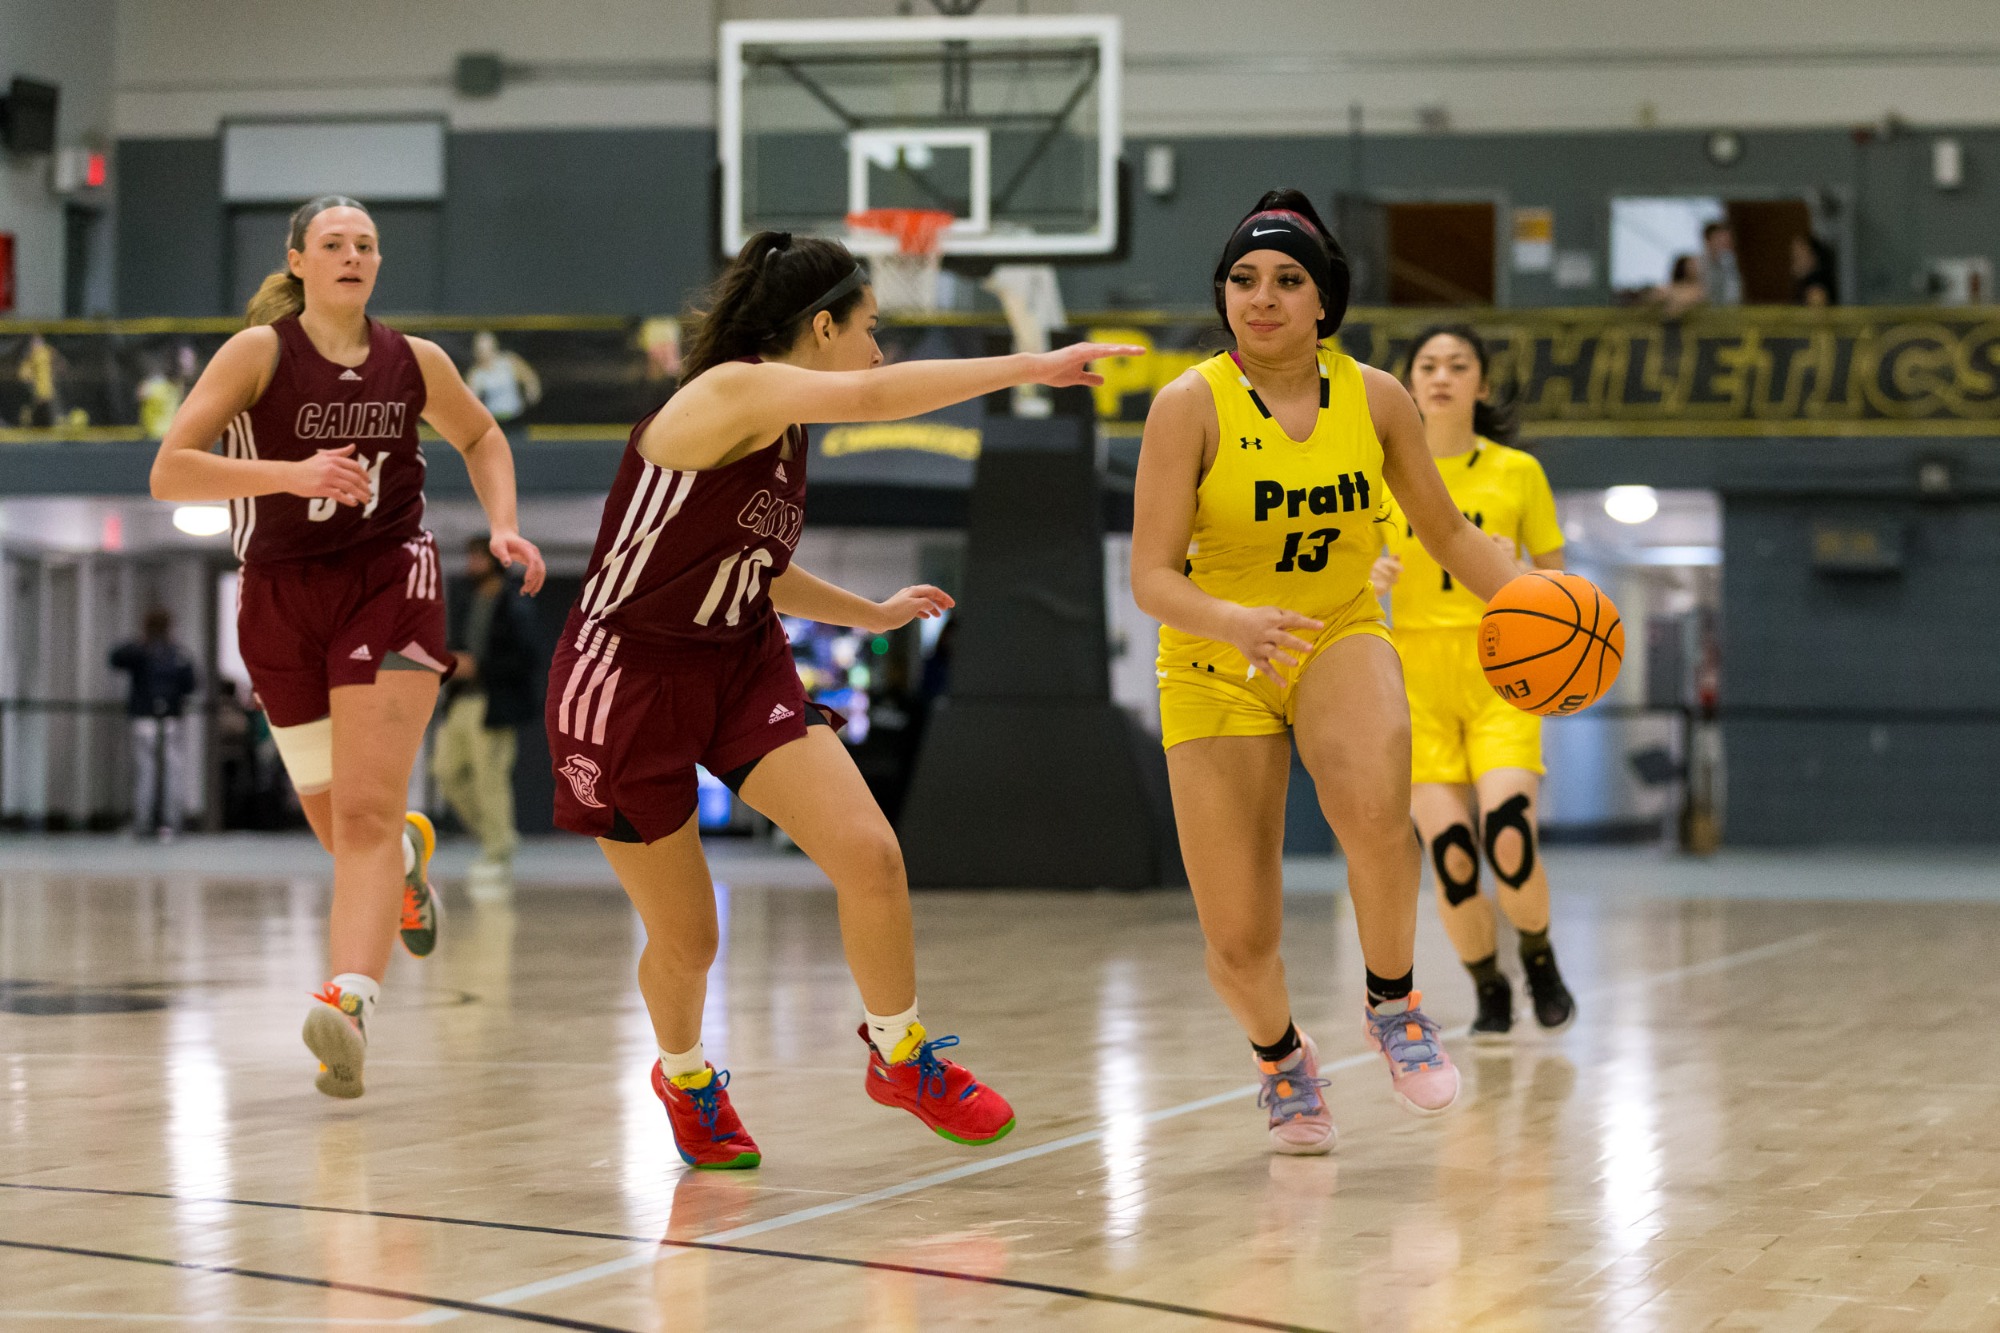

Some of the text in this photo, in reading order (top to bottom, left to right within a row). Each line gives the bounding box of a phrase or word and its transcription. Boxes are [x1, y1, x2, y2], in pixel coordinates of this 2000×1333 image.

[1378, 326, 2000, 420] HLETICS
[296, 402, 406, 439] CAIRN
[1255, 470, 1370, 521] Pratt
[1275, 527, 1341, 572] 13
[768, 710, 795, 725] adidas
